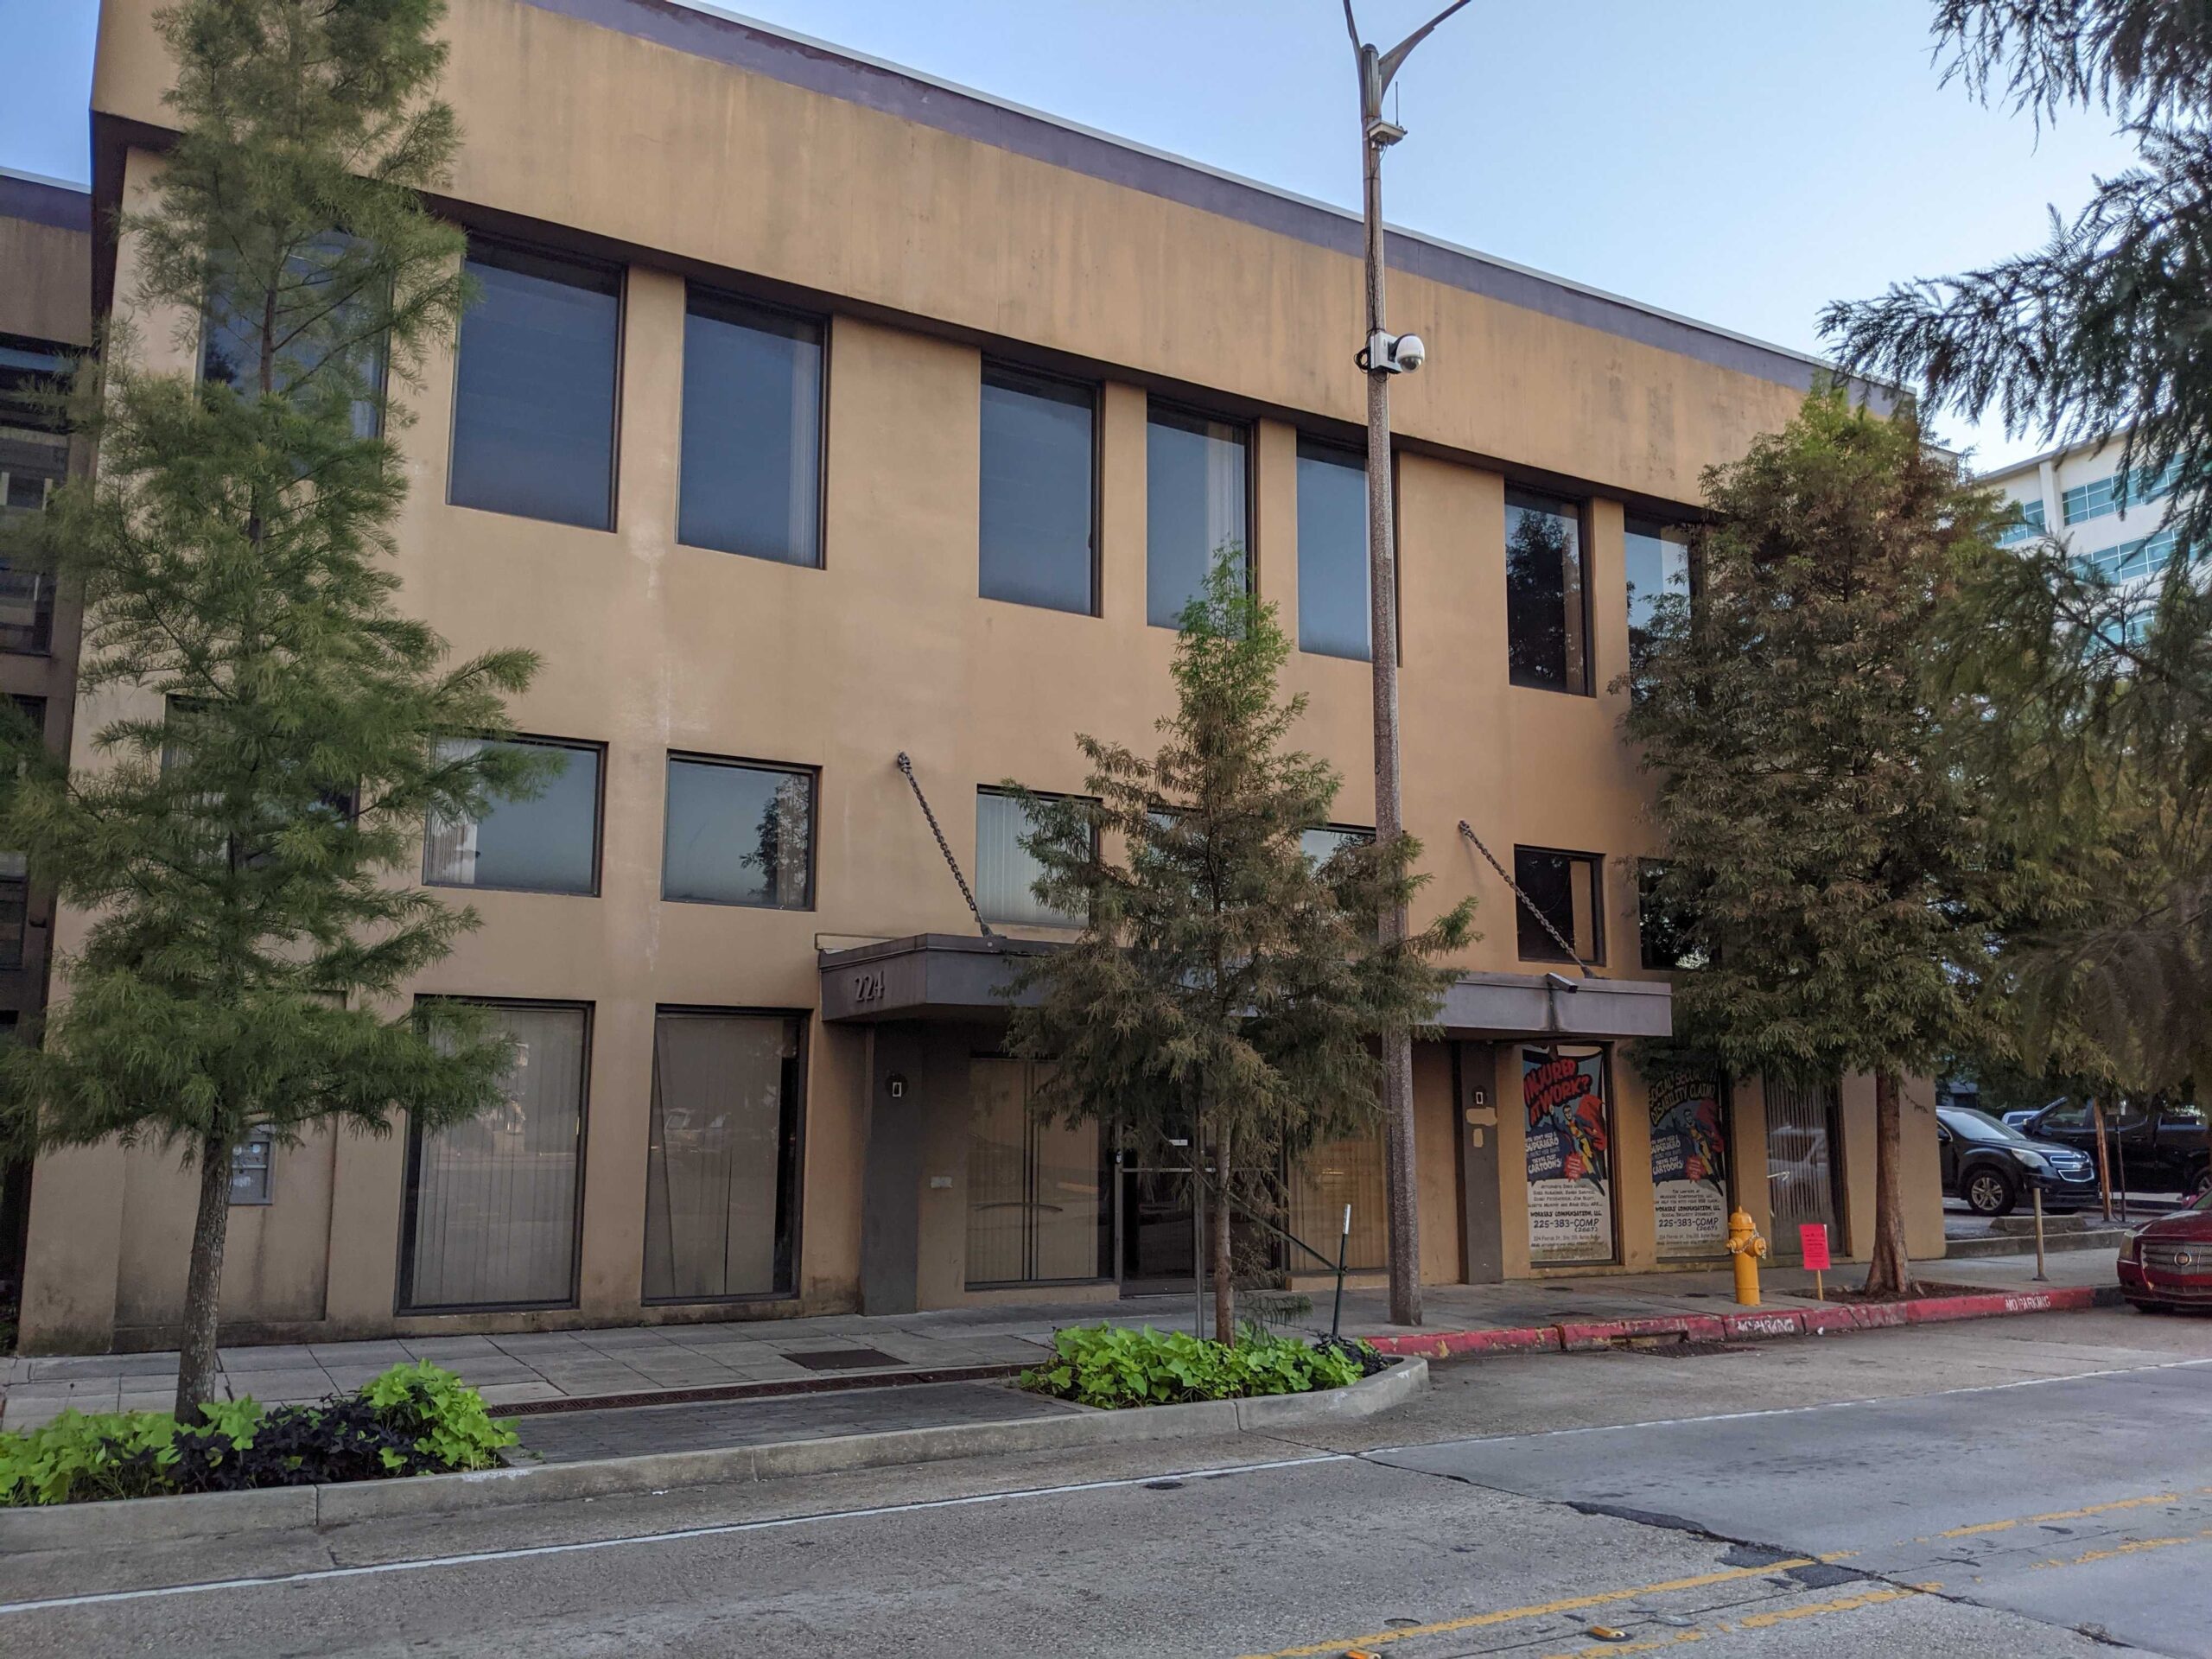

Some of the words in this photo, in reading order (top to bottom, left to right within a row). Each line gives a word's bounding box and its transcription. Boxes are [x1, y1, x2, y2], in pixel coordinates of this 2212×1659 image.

[855, 969, 885, 1002] 224
[1524, 1058, 1577, 1106] INJURED
[1540, 1075, 1591, 1114] WORK?
[1649, 1085, 1688, 1126] DISABILITY
[1525, 1137, 1559, 1153] SUPERHERO
[1534, 1218, 1599, 1228] 225-383-COMP
[1658, 1217, 1719, 1227] 225-383-COMP
[2006, 1299, 2018, 1312] NO
[2018, 1295, 2051, 1311] PARKING
